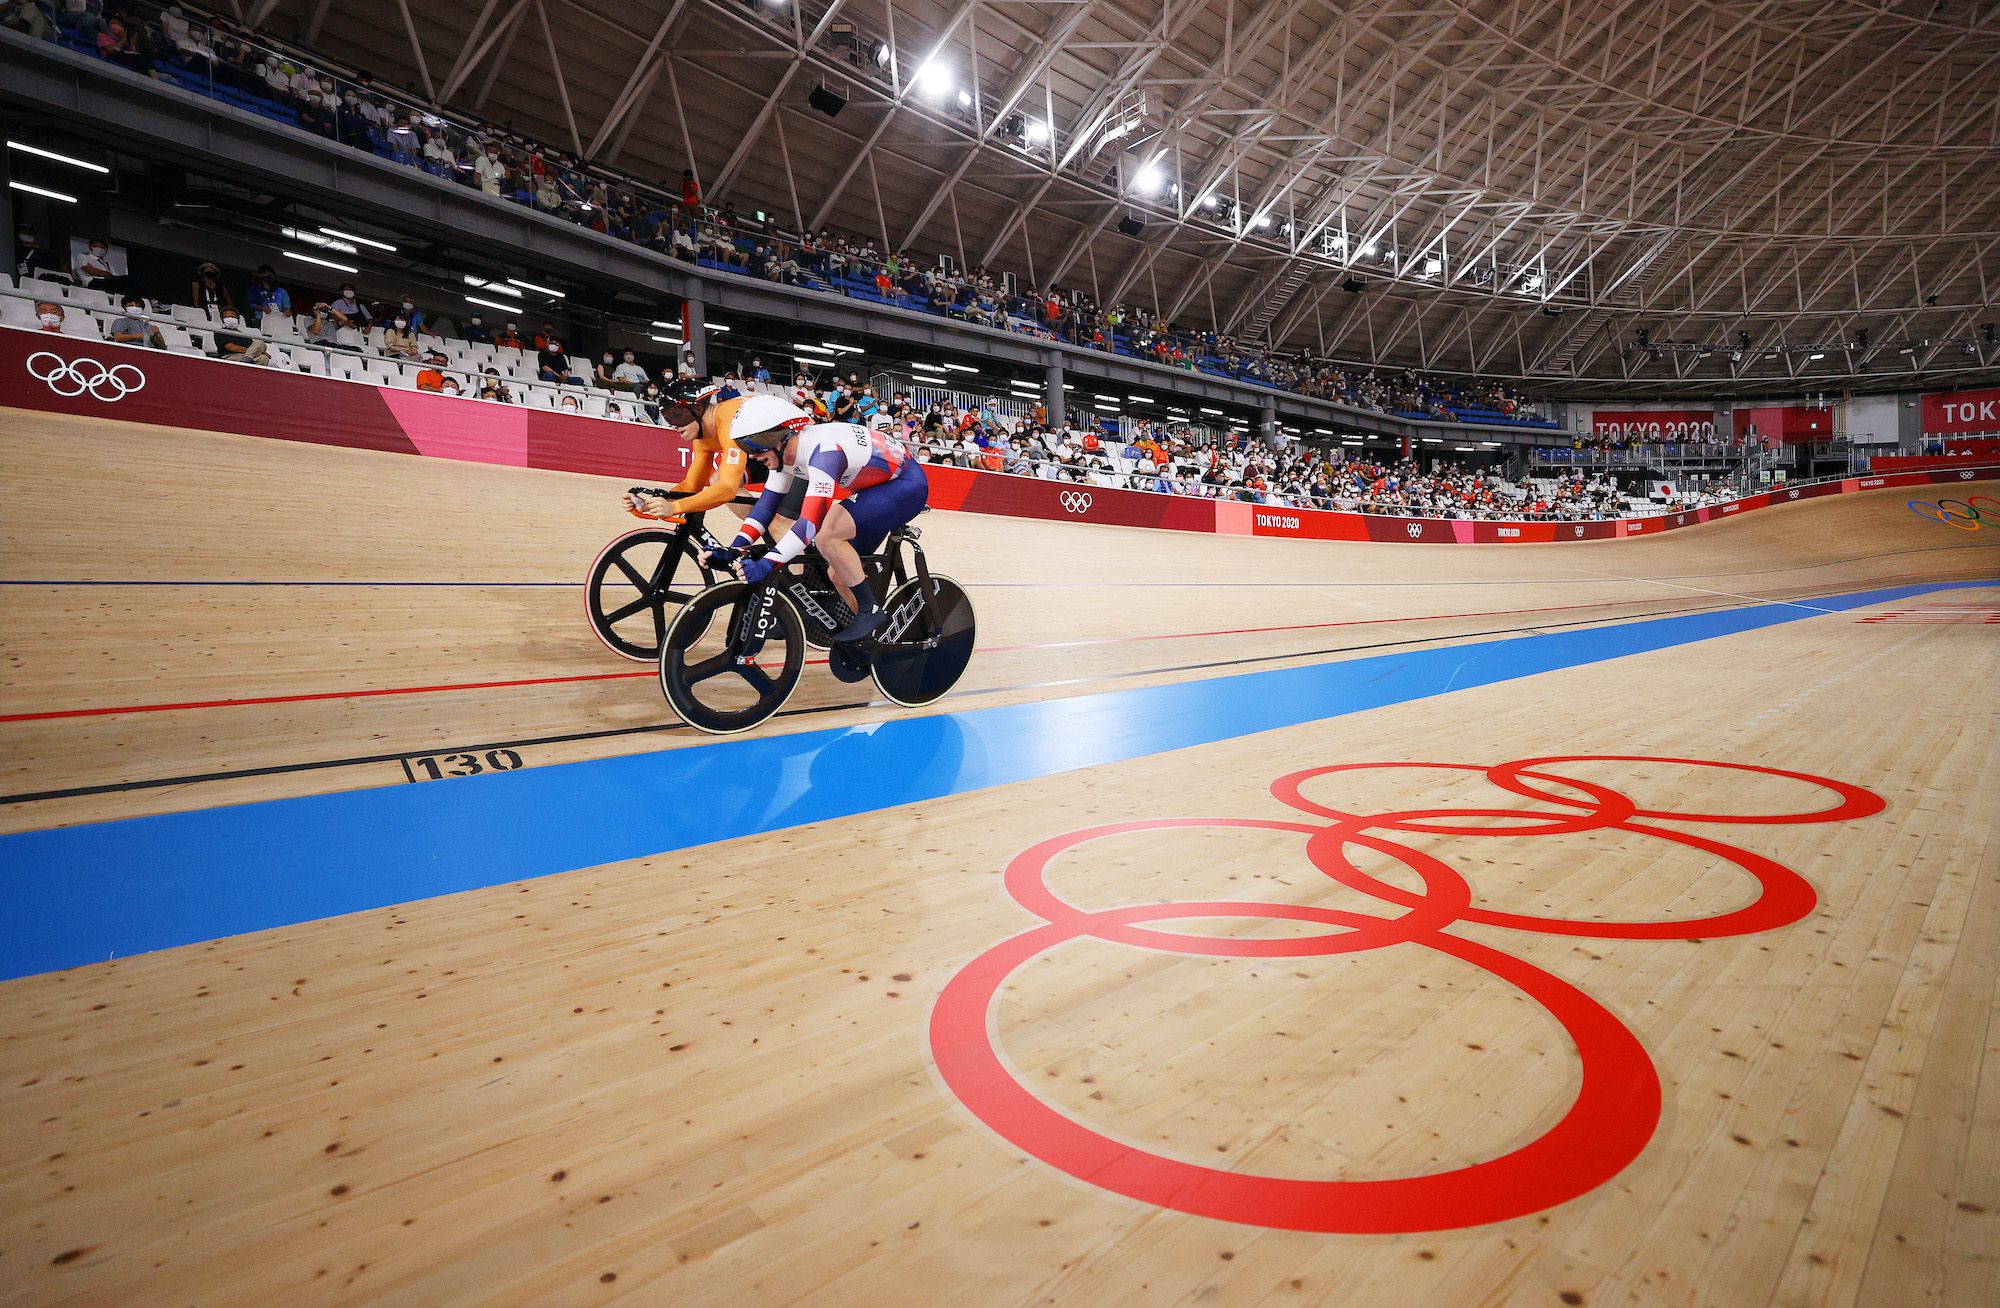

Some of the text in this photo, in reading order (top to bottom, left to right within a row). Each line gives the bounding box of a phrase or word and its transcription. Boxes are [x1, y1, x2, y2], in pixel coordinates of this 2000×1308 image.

[1942, 400, 2000, 424] TOK
[1596, 422, 1660, 443] TOKYO
[1256, 514, 1300, 529] TOKYO 2020
[754, 586, 776, 639] LOTUS
[416, 749, 523, 779] 130
